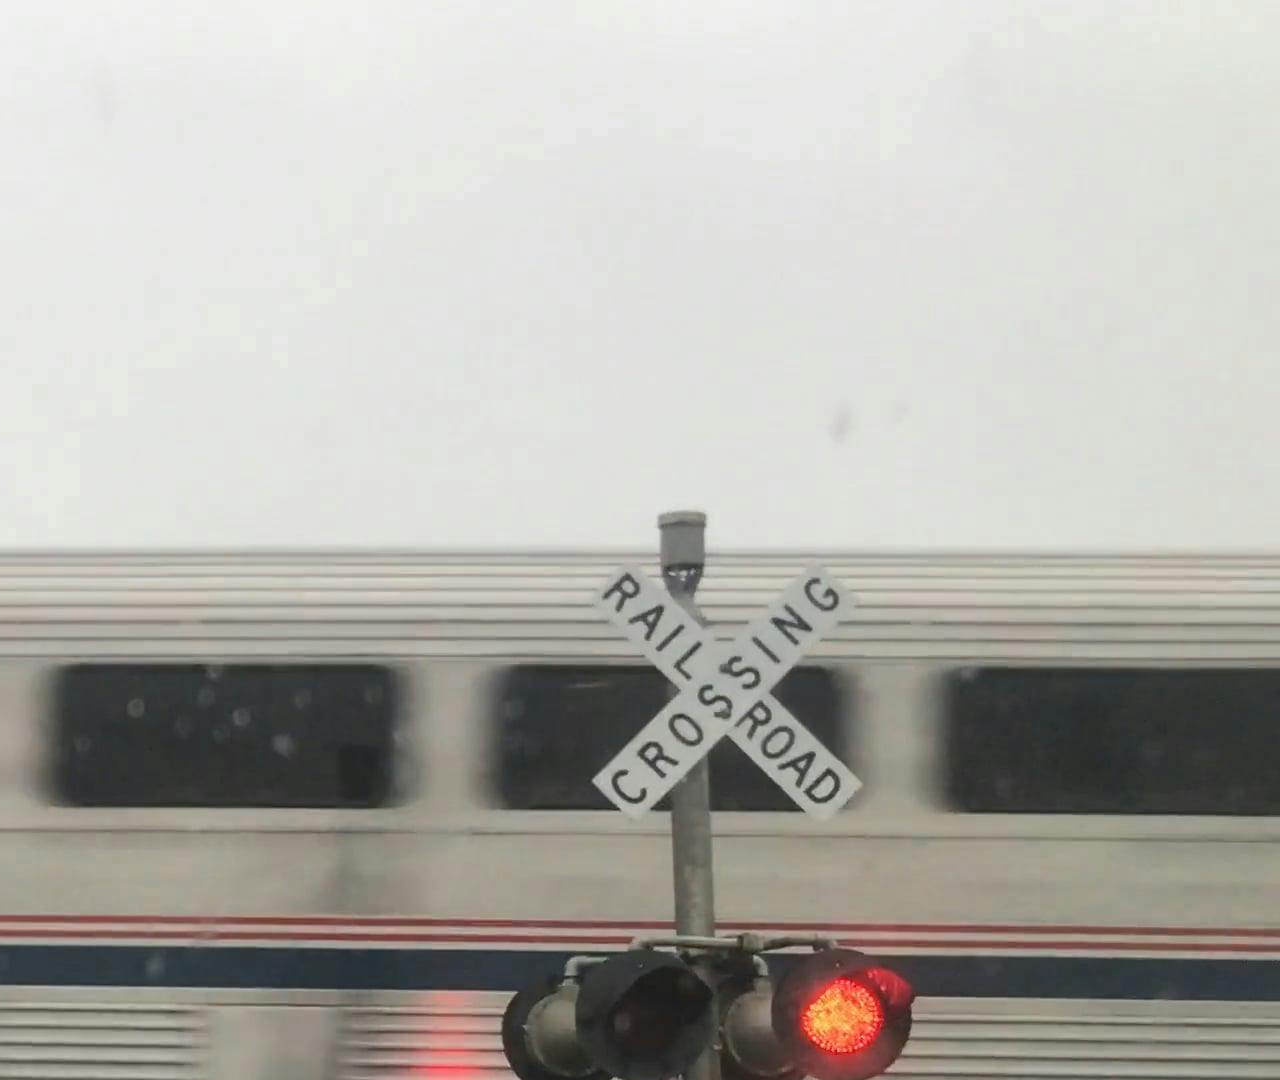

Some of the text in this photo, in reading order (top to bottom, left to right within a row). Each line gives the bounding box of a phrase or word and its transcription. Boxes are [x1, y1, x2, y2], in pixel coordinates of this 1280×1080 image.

[602, 572, 841, 804] RAIL ROAD
[611, 577, 840, 804] CROSSING
